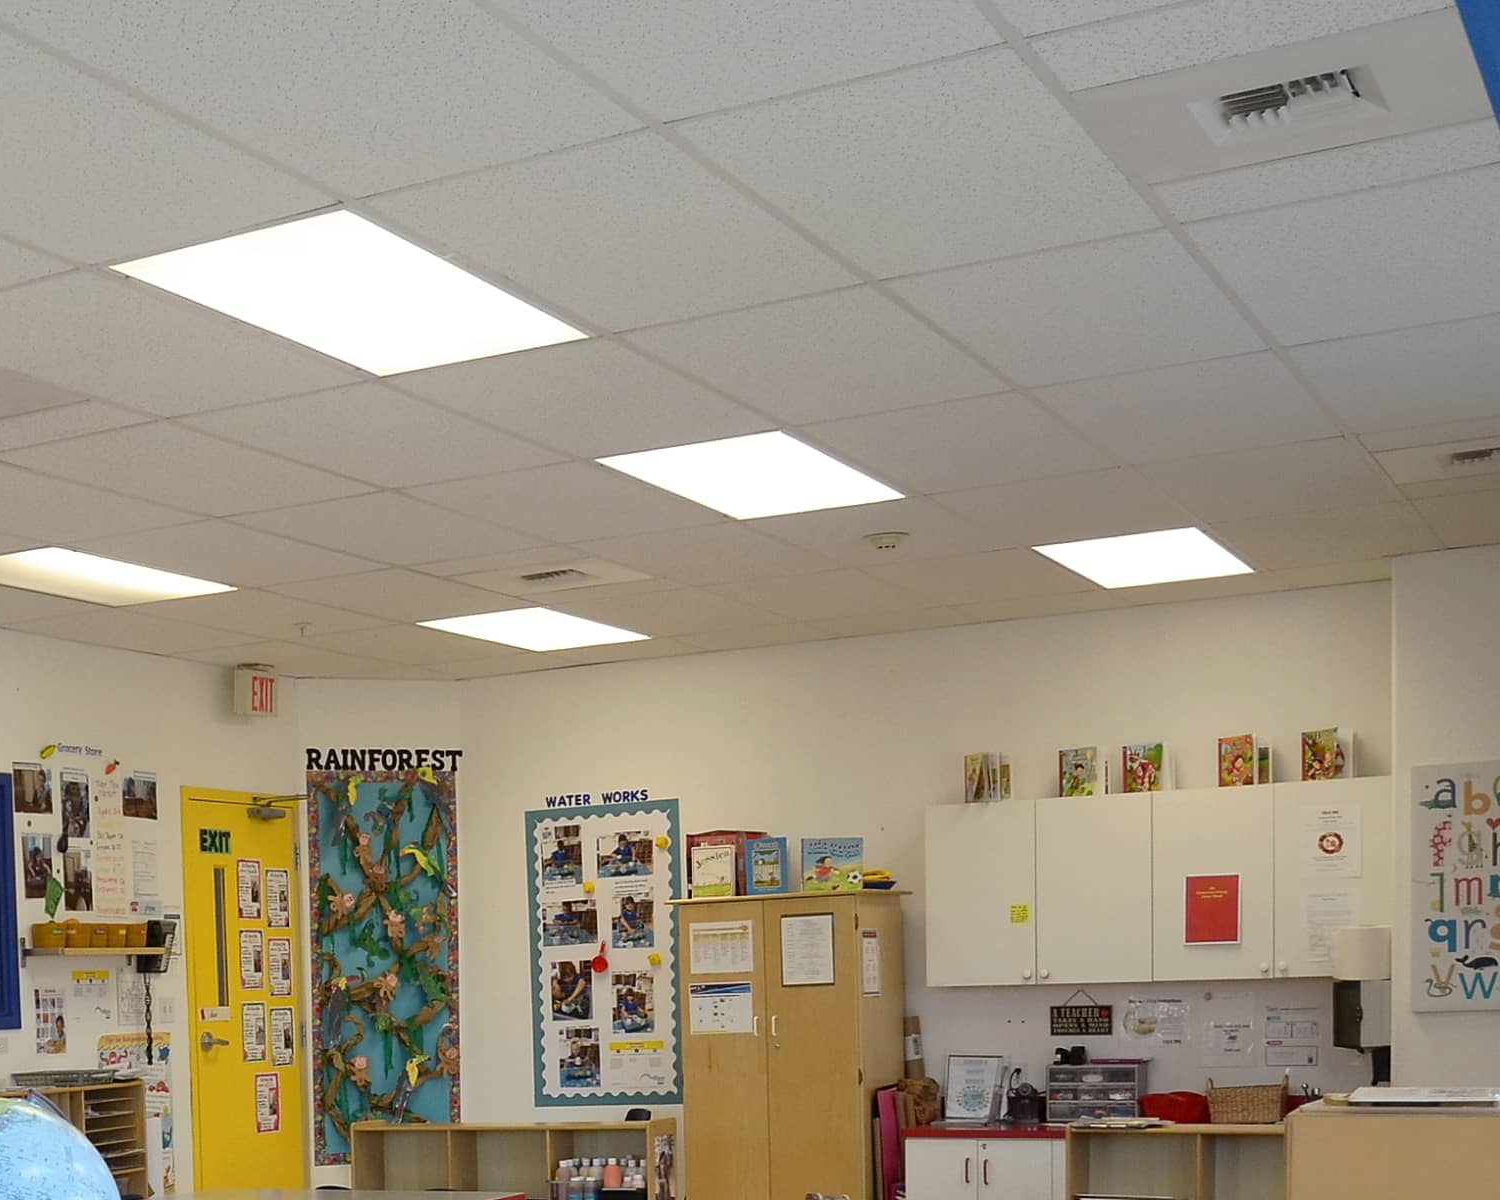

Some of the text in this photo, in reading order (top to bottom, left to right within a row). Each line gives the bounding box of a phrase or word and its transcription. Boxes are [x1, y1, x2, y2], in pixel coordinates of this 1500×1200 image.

[252, 676, 275, 713] EXIT
[57, 743, 103, 756] Grocery Store
[306, 748, 463, 772] RAINFOREST
[546, 789, 649, 808] WATER WORKS
[1433, 778, 1491, 816] a b
[200, 828, 231, 854] EXIT
[1454, 876, 1483, 906] m
[1464, 918, 1487, 950] r
[1458, 971, 1498, 1000] w
[1060, 1007, 1100, 1018] TEACHER
